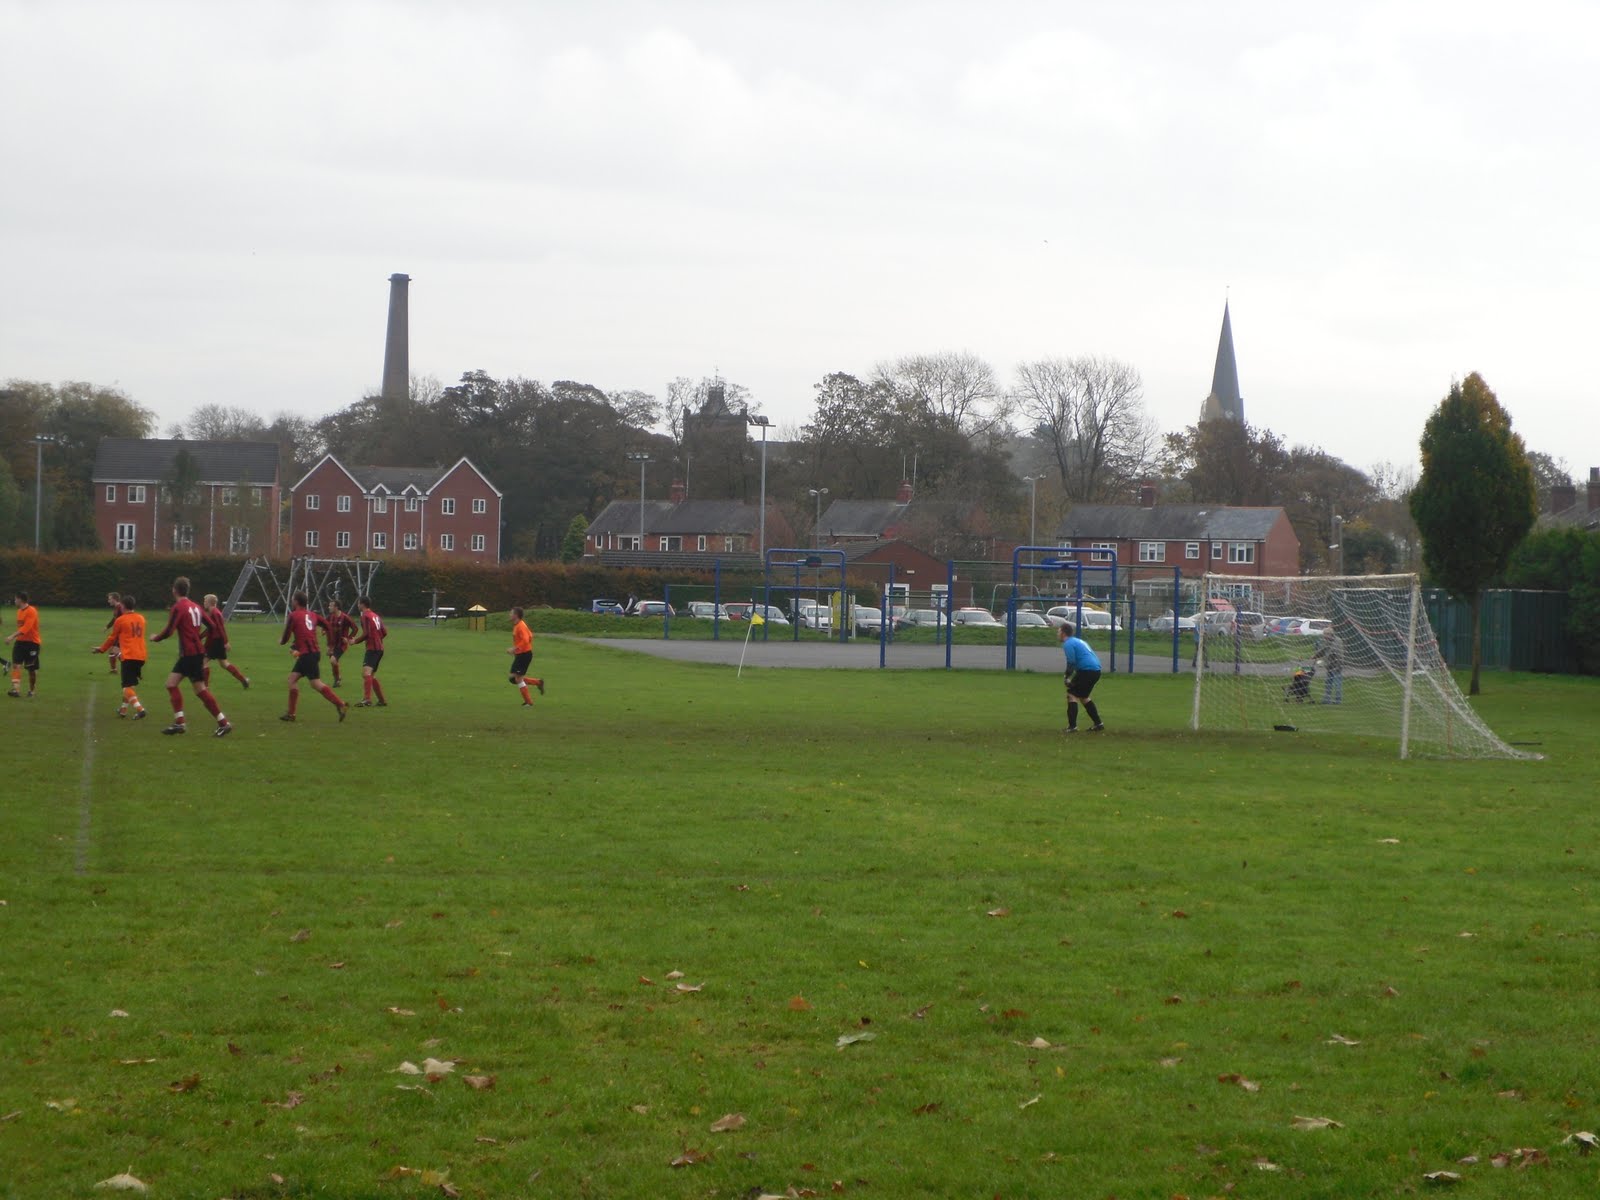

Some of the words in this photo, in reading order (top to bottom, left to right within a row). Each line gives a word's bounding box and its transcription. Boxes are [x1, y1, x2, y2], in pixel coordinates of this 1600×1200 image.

[188, 606, 201, 627] 11
[305, 614, 313, 631] 6
[130, 621, 142, 638] 16
